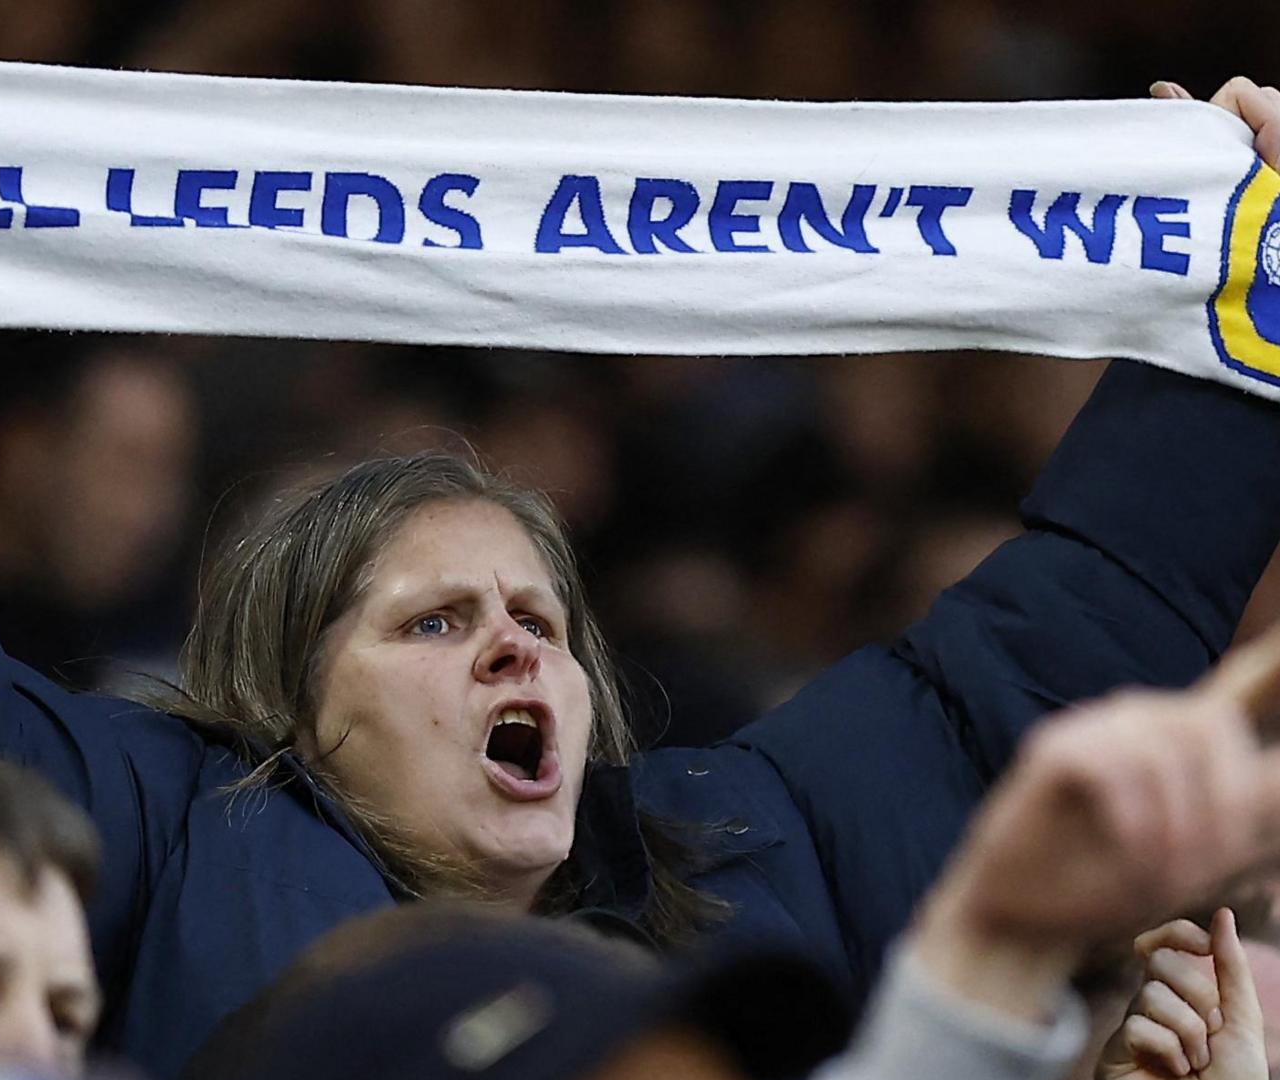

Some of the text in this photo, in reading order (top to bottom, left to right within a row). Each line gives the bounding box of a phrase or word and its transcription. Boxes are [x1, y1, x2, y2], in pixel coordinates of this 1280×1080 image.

[105, 168, 484, 250] LEEDS
[534, 174, 974, 256] AREN'T
[1007, 189, 1192, 276] WE
